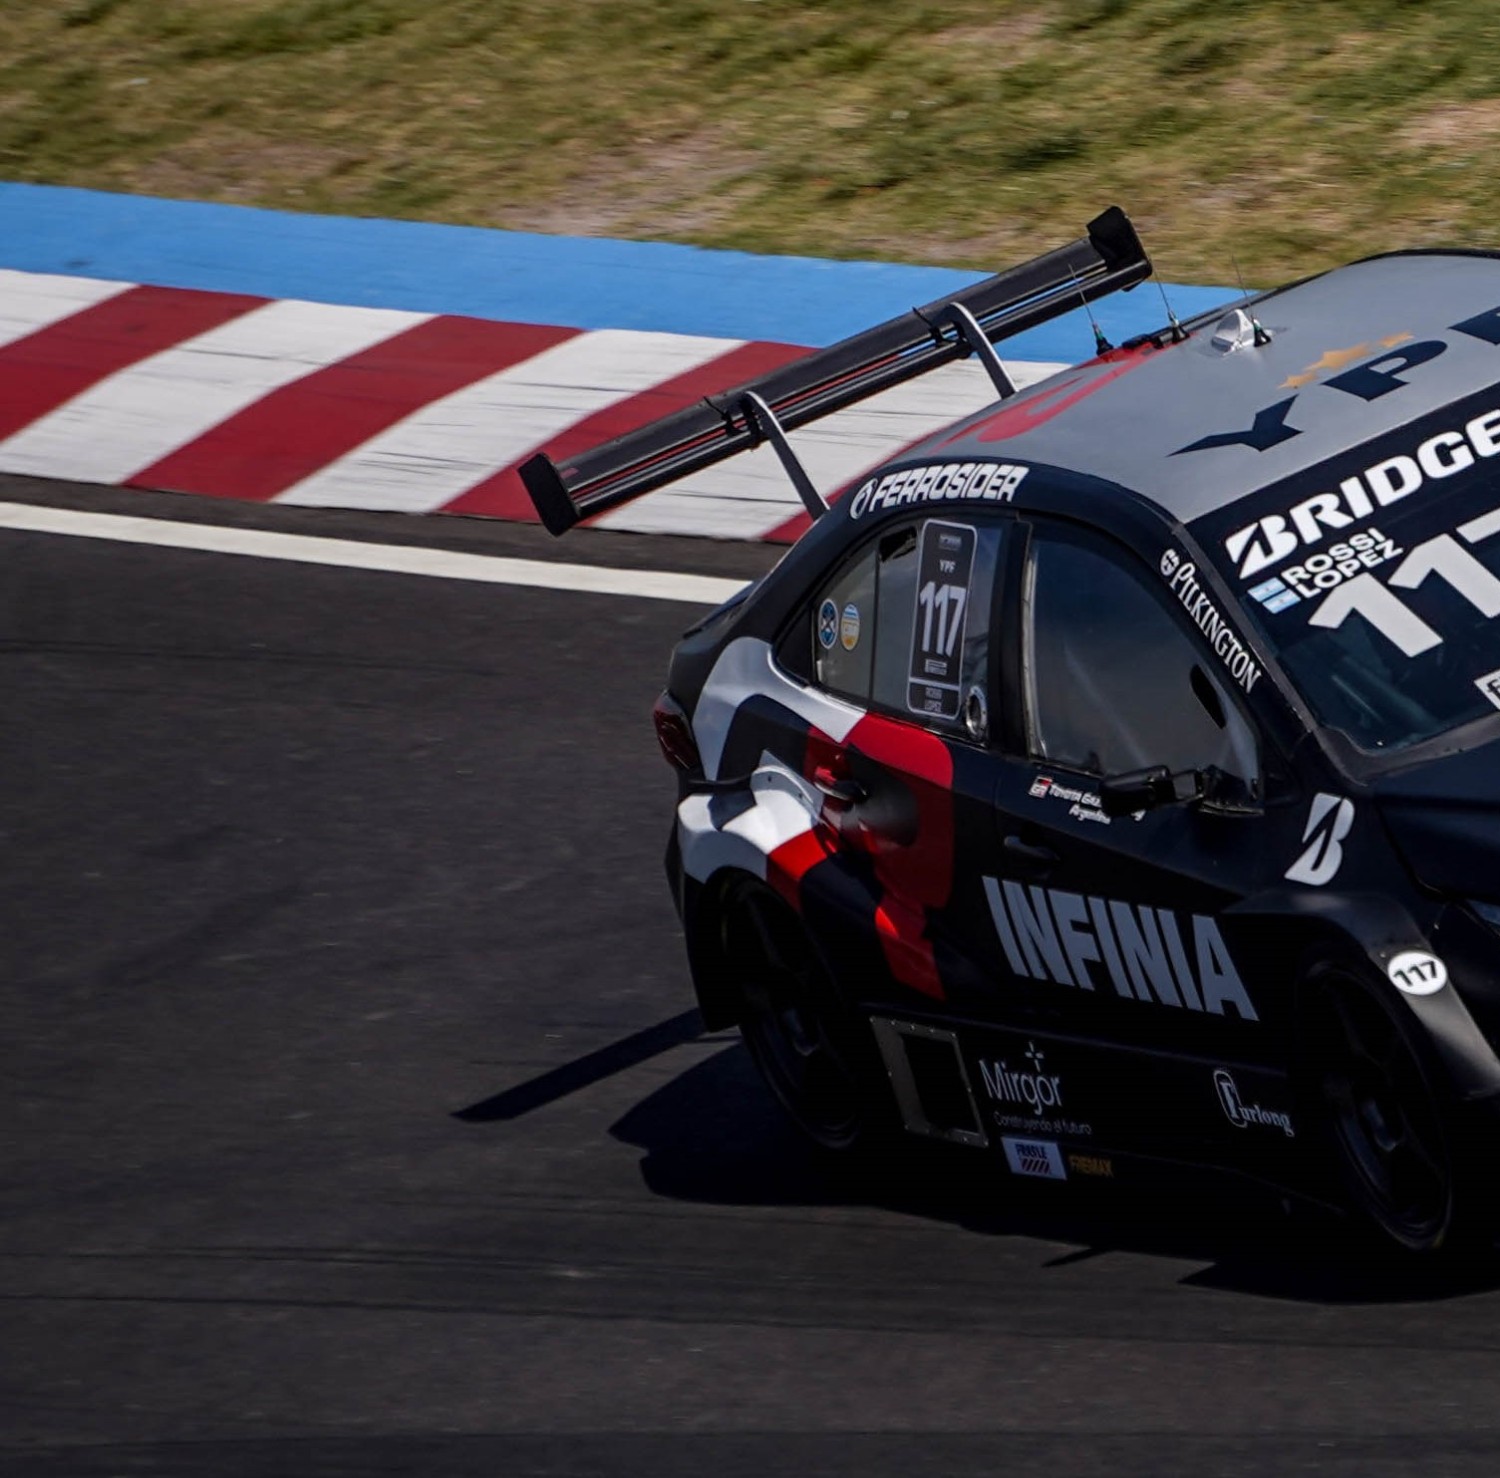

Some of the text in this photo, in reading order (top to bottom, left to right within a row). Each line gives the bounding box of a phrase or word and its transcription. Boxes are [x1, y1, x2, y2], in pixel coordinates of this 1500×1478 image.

[869, 463, 1029, 512] FERROSIDER
[1281, 527, 1388, 585] ROSSI
[1296, 541, 1403, 598] LOPEZ
[920, 581, 967, 657] 117
[1174, 563, 1262, 694] PILKINGTON
[981, 875, 1259, 1021] INFINIA
[1393, 960, 1437, 987] 117
[978, 1058, 1063, 1115] Mirgor
